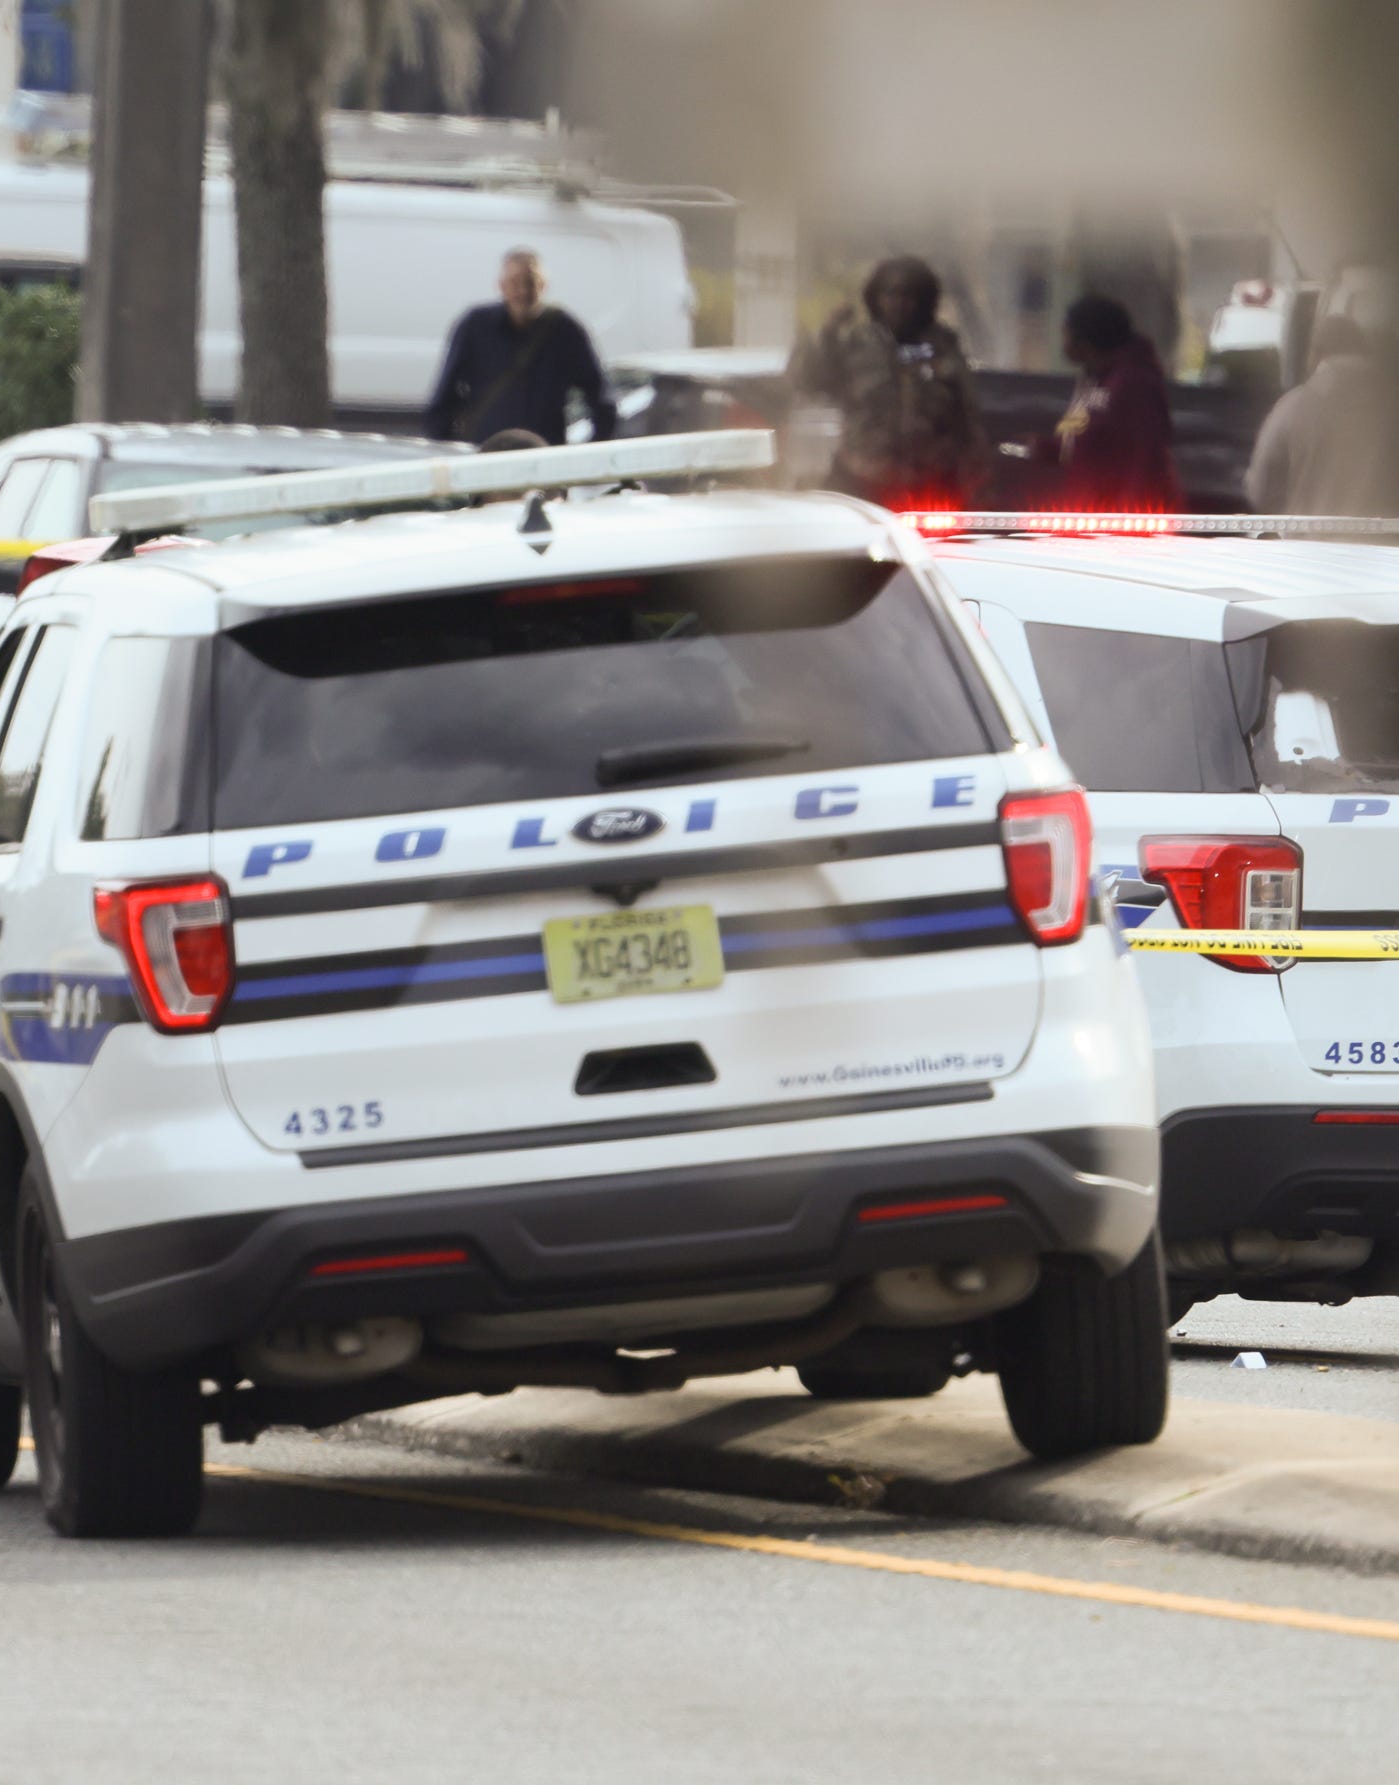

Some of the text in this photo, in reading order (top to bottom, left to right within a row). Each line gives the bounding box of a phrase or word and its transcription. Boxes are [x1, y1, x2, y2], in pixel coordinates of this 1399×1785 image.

[241, 774, 976, 880] POLICE
[590, 809, 647, 838] Ford
[573, 930, 691, 981] XG4348
[284, 1101, 384, 1135] 4325
